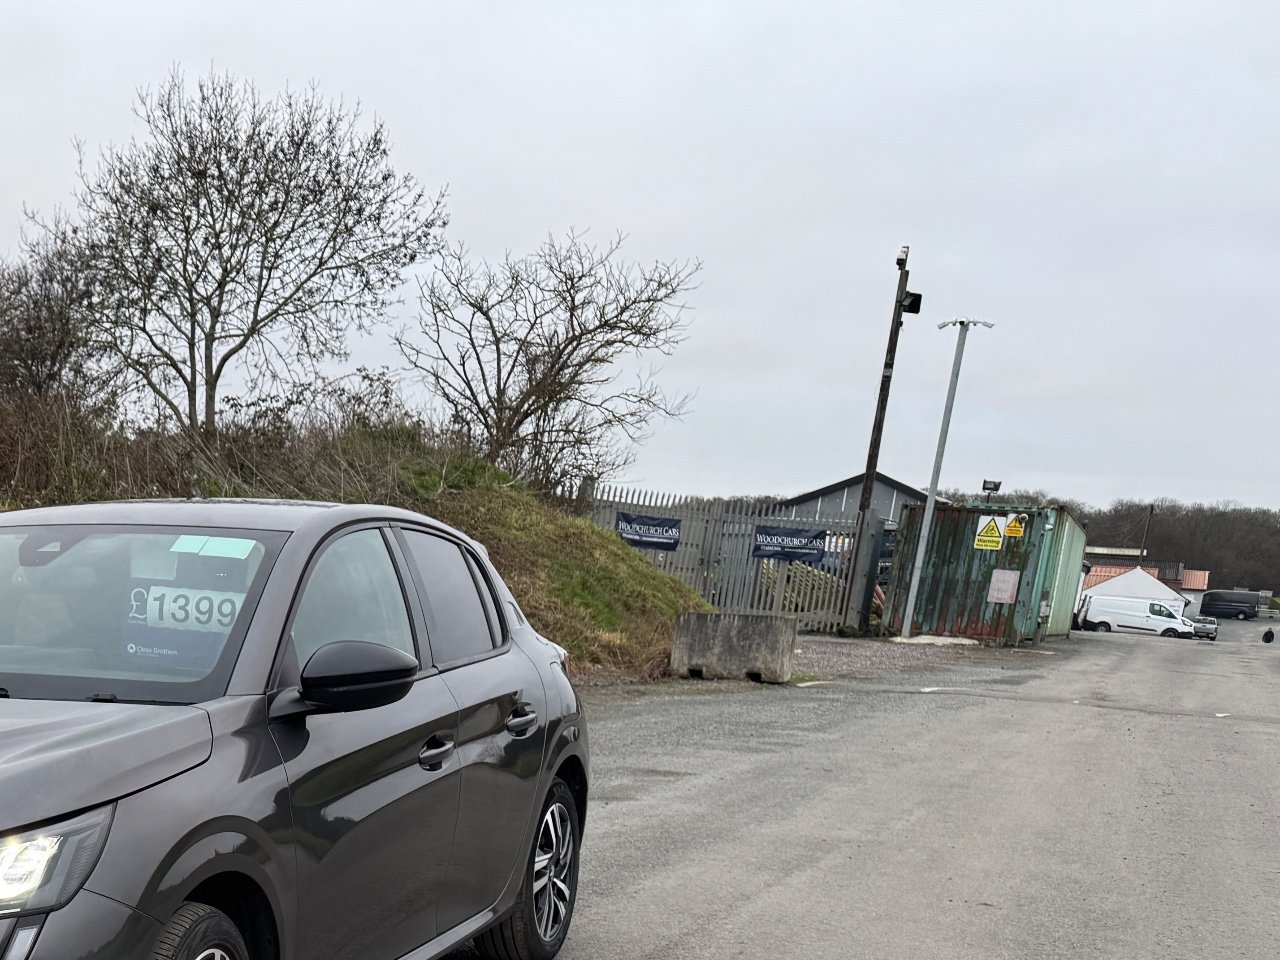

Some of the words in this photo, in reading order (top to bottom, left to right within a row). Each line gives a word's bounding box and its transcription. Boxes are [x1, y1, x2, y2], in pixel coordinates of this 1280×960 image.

[618, 521, 663, 535] WOODCHURCH
[663, 526, 680, 536] CARS
[756, 533, 808, 545] WOODCHURCH
[808, 538, 824, 547] CARS
